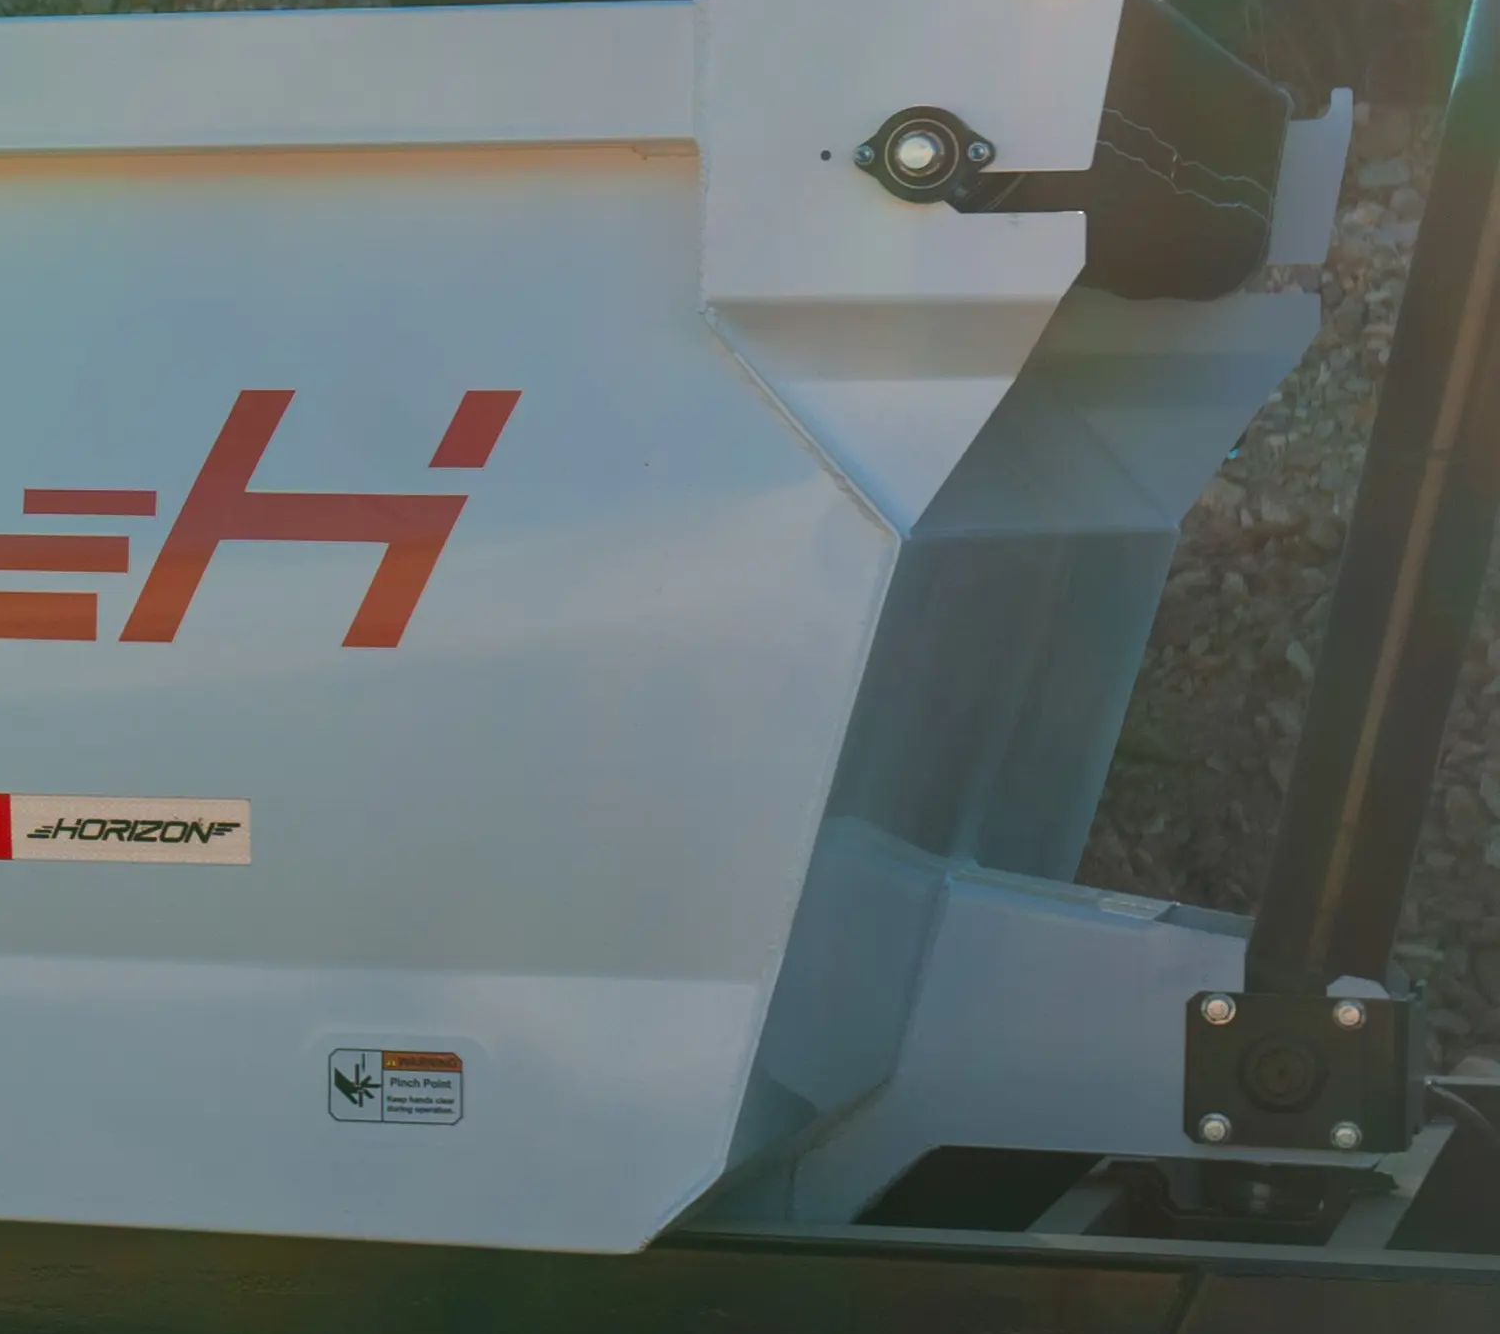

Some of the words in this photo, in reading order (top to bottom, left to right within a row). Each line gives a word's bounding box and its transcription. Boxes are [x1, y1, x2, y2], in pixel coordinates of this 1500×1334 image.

[50, 817, 218, 844] HORIZON
[389, 1077, 420, 1088] Pinch
[423, 1078, 452, 1090] Point
